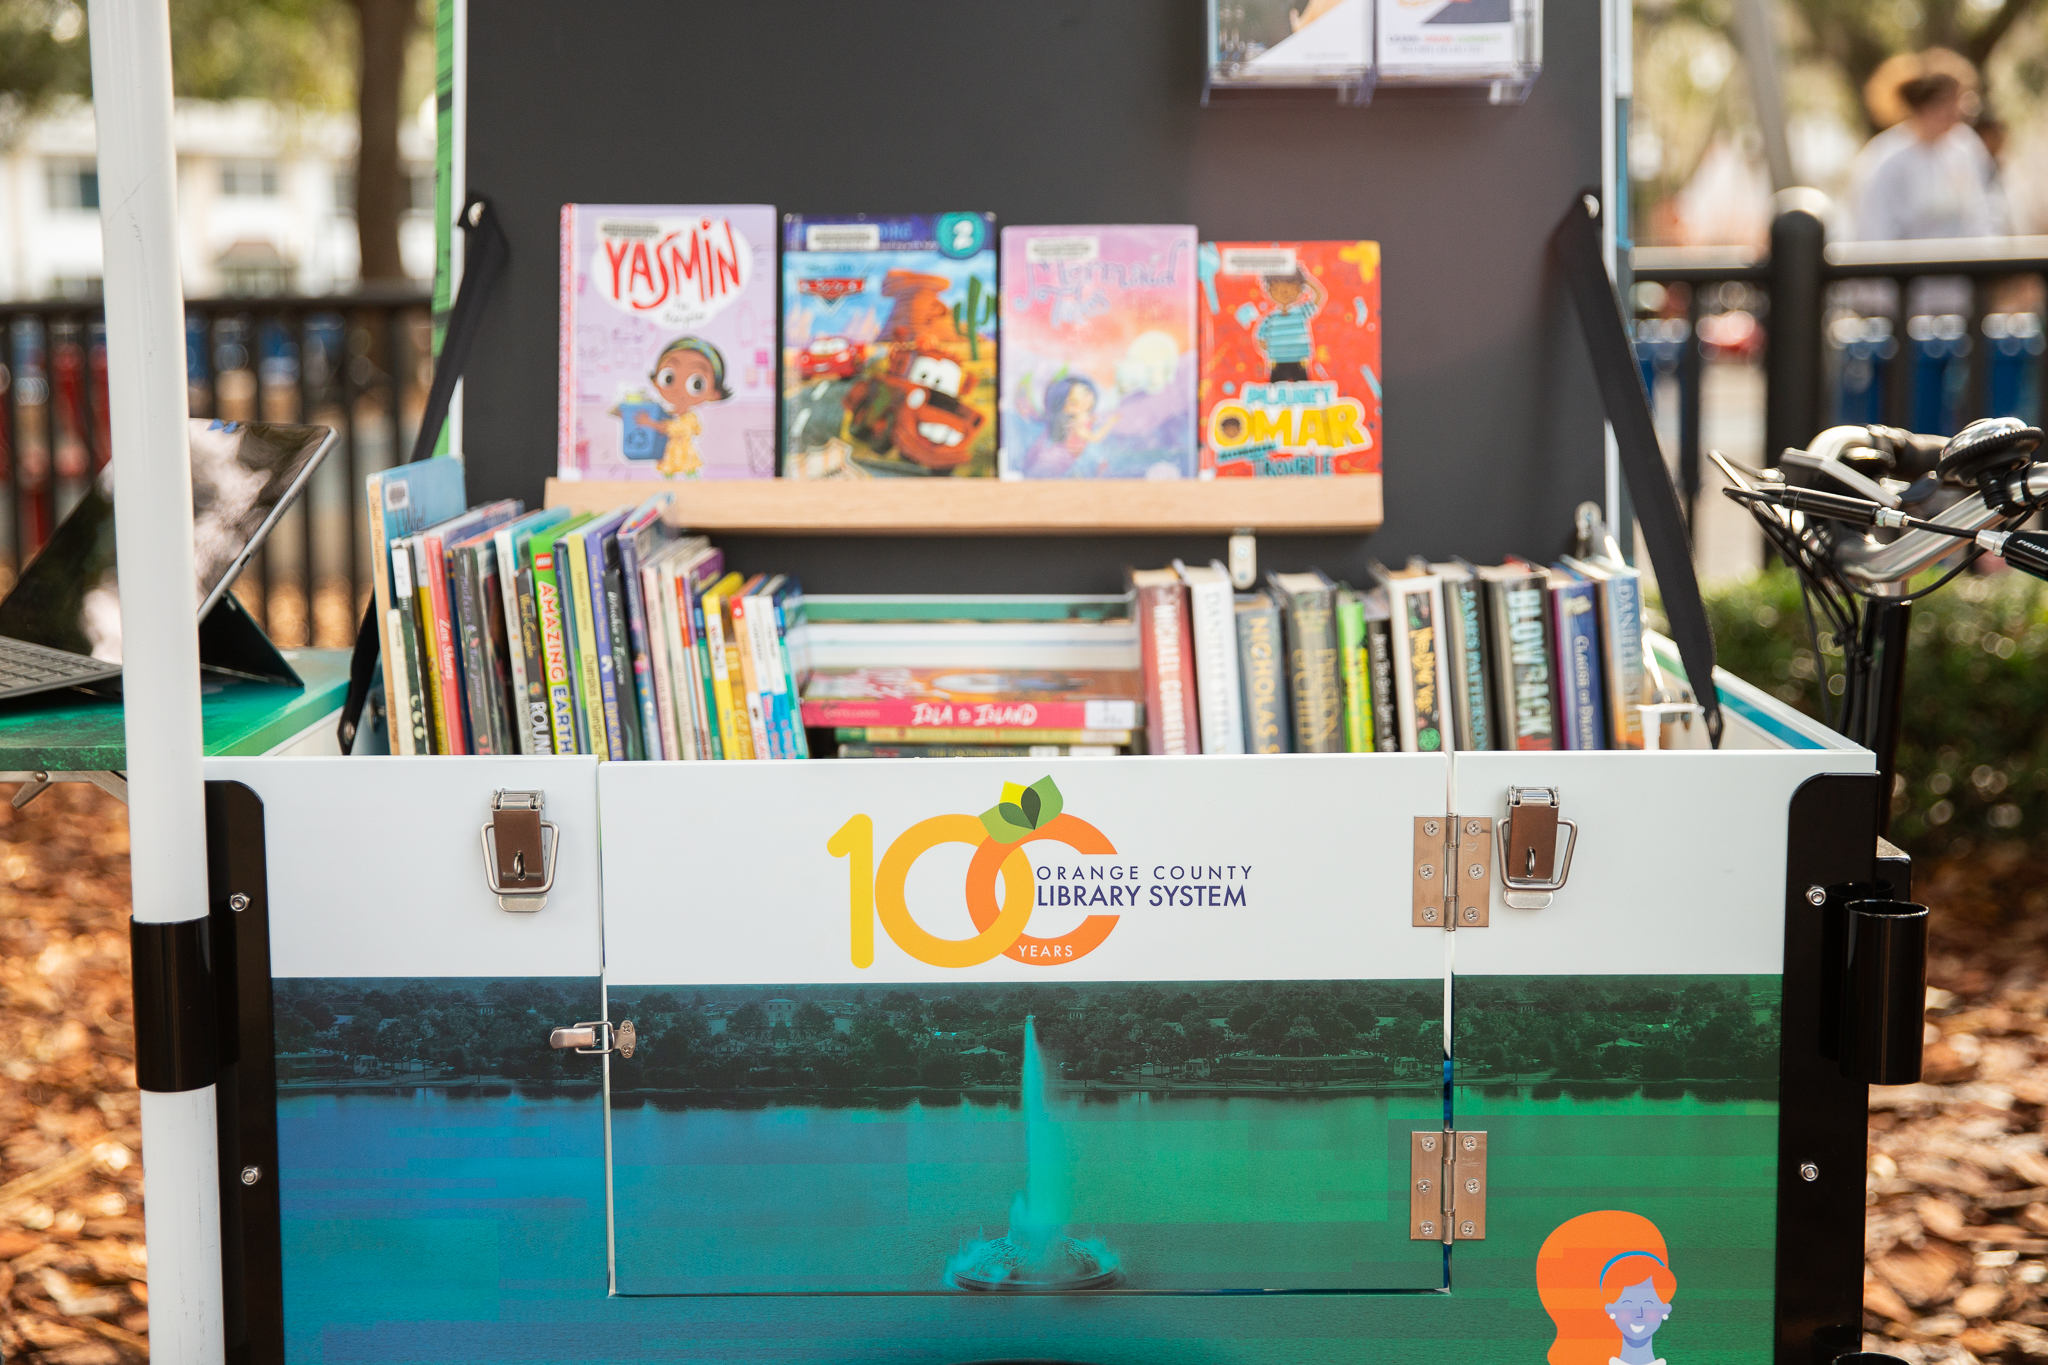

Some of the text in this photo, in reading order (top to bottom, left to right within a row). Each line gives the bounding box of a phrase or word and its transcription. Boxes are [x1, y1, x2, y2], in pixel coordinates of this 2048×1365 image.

[952, 220, 975, 250] 2
[604, 217, 740, 310] YASMIN
[1247, 387, 1332, 405] PLANET
[1214, 404, 1365, 449] OMAR
[438, 618, 450, 642] Zen
[1153, 604, 1181, 675] MICHAEL
[1617, 584, 1641, 675] DANIELLE
[441, 645, 456, 681] Shorts
[536, 581, 576, 754] AMAZING EARTH
[1251, 616, 1279, 739] NICHOLAS
[1459, 590, 1488, 750] JAMES PATTERSON
[1507, 589, 1552, 735] BLOWBACK
[1574, 634, 1591, 690] CLAUSE
[530, 701, 552, 754] ROUN
[912, 703, 953, 726] ISLA
[973, 703, 1038, 726] ISLAND
[1036, 865, 1252, 881] ORANGE COUNTY
[1037, 884, 1247, 907] LIBRARY SYSTEM
[1018, 944, 1073, 958] YEARS
